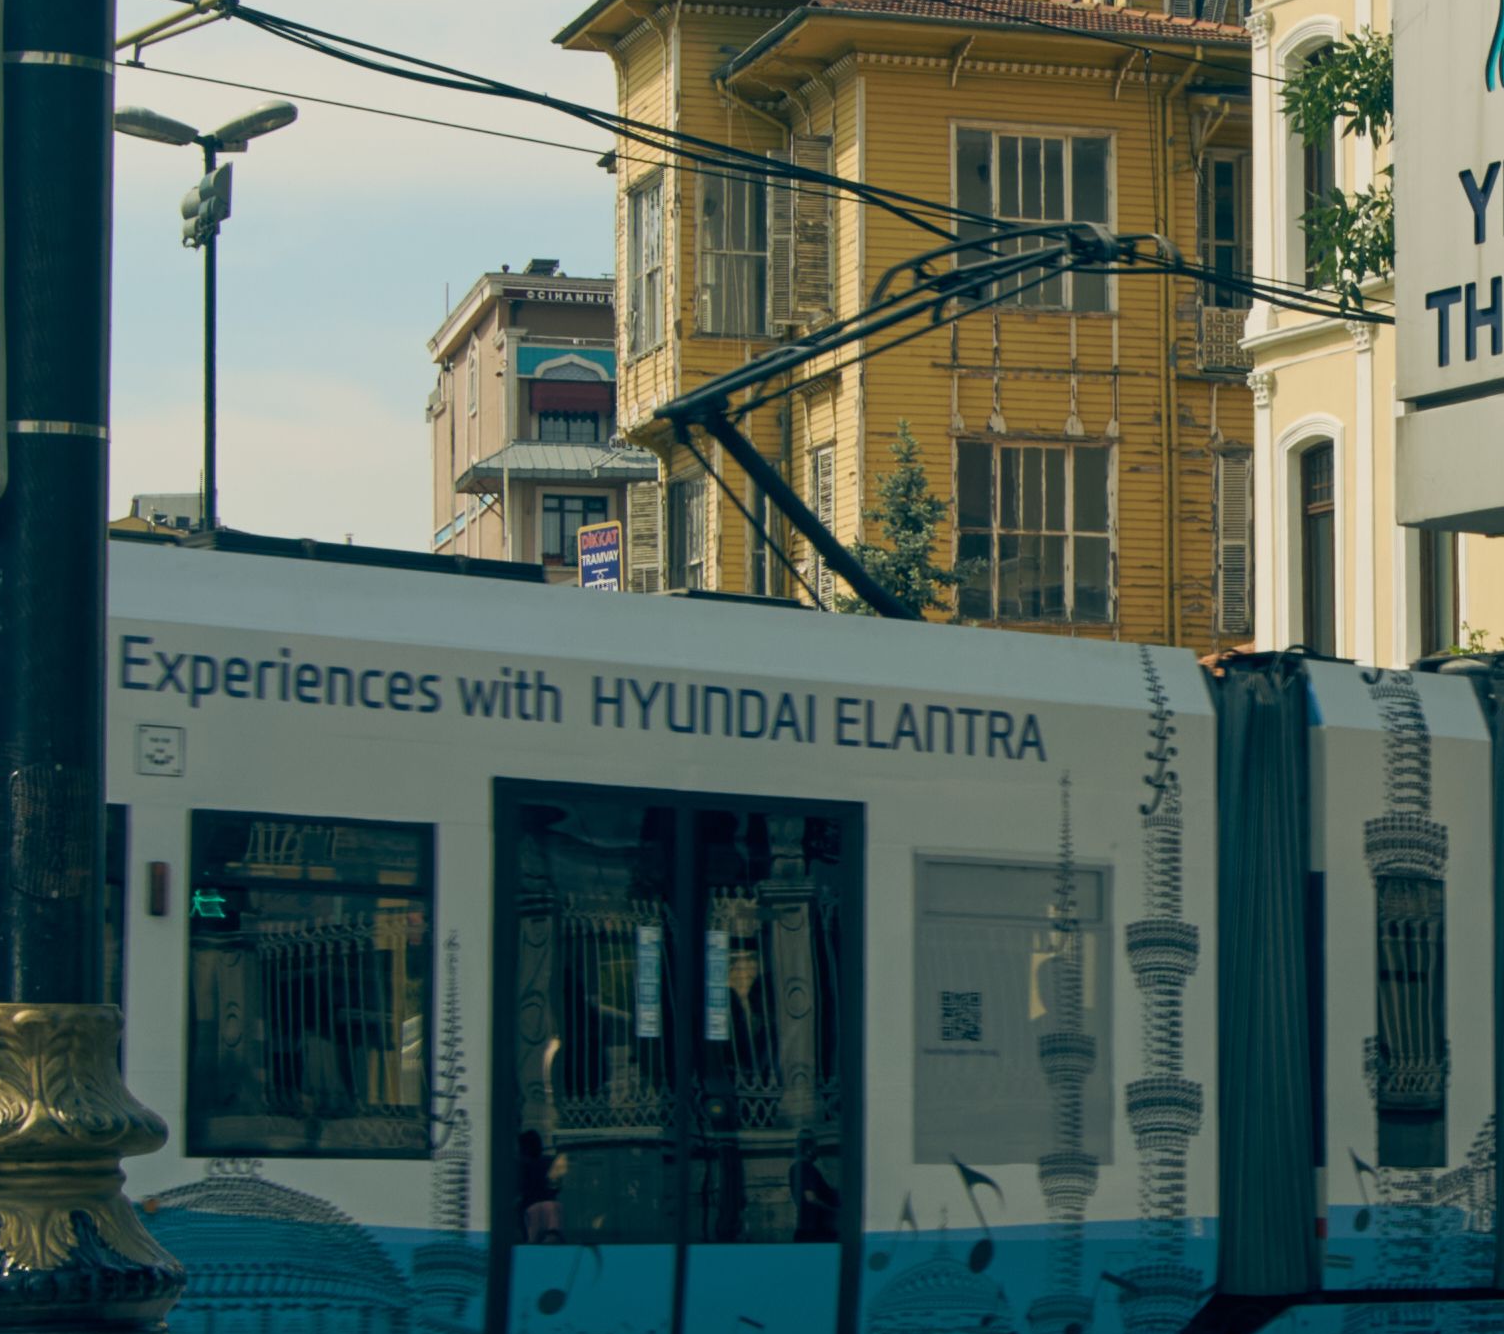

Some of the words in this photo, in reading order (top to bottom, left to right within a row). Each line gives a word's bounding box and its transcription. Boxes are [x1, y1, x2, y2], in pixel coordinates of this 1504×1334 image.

[582, 550, 619, 567] TRAMVAY
[119, 634, 443, 713] Experiences
[456, 665, 563, 724] with
[592, 675, 816, 743] HYUNDAI
[834, 696, 1048, 763] ELANTRA
